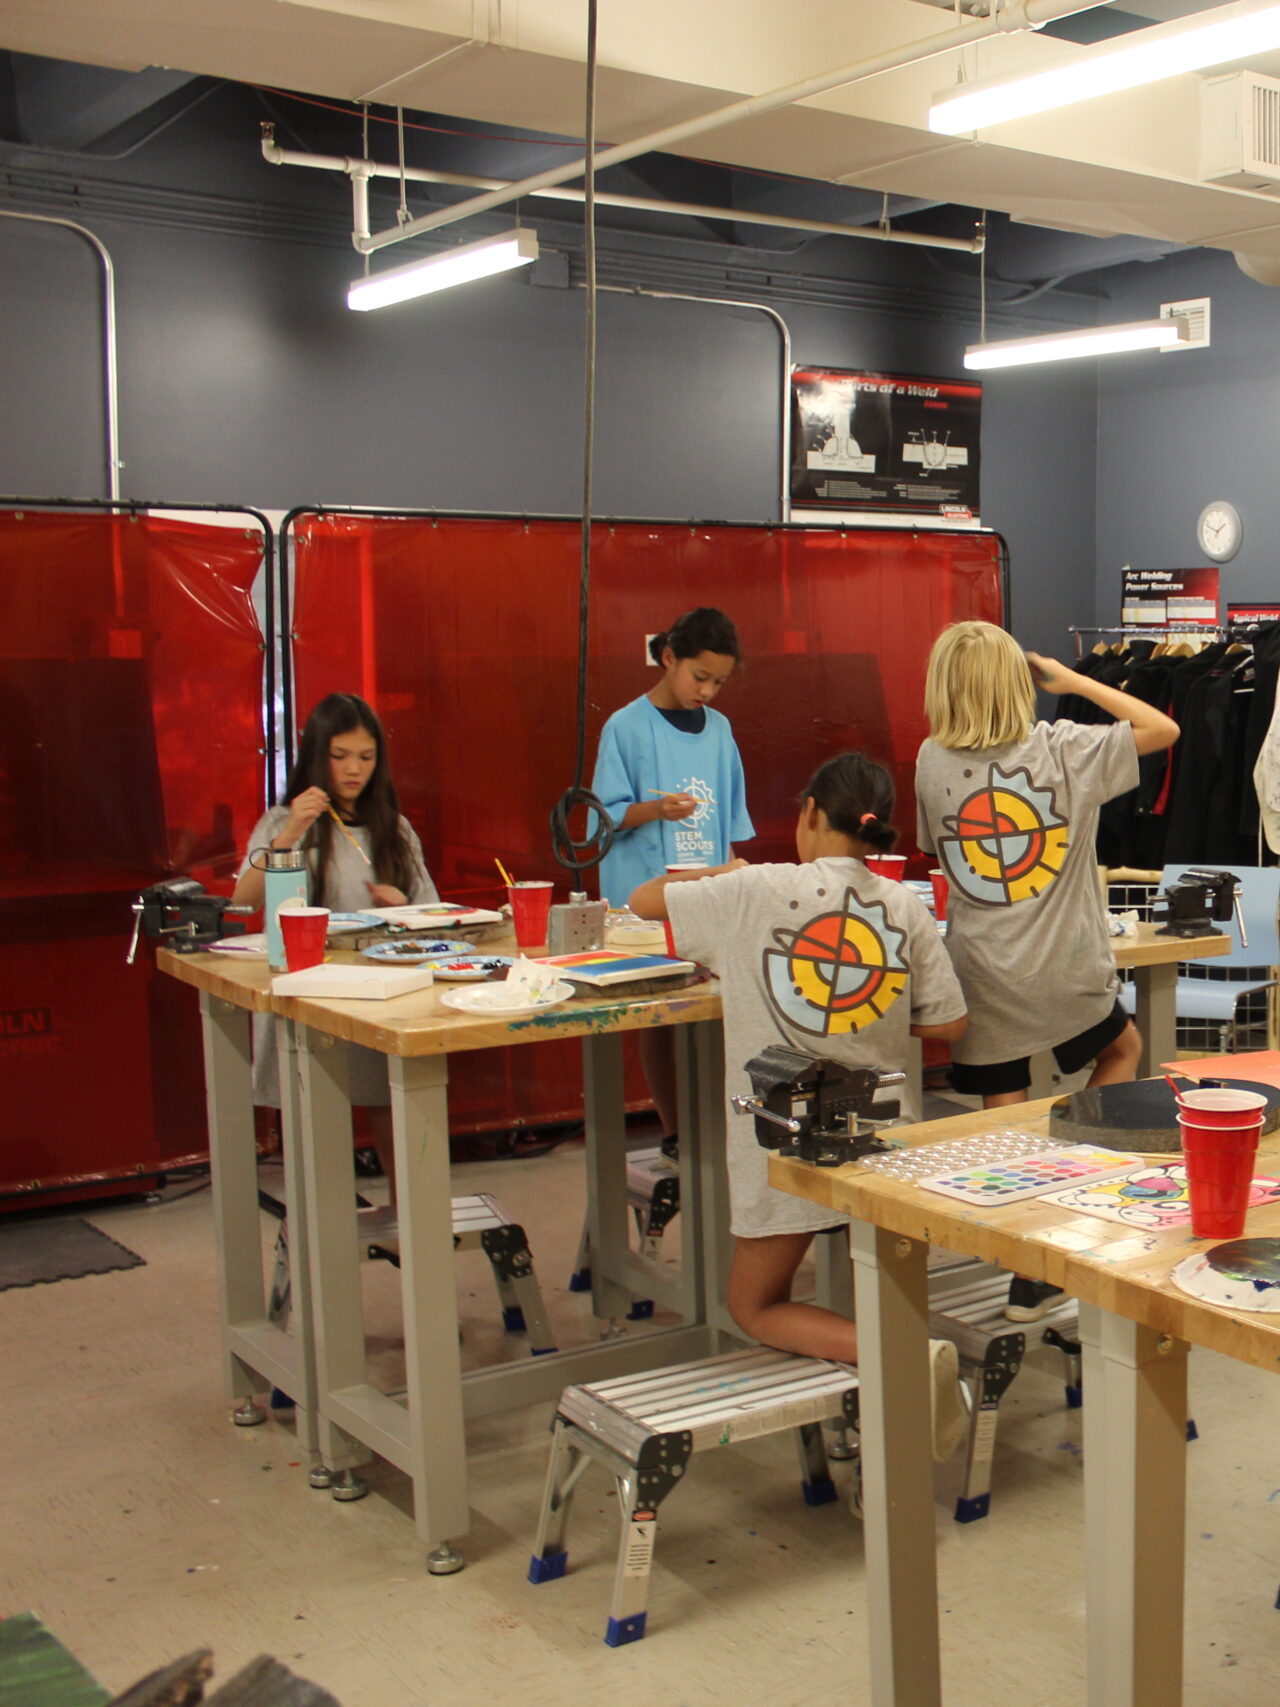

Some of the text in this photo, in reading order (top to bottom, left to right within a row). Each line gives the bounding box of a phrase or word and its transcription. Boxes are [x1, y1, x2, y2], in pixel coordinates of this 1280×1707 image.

[908, 385, 939, 397] Weld
[1125, 572, 1173, 582] Arc Welding
[1125, 582, 1184, 591] Power Sources
[674, 832, 702, 841] STEM
[676, 841, 714, 851] SCOUTS
